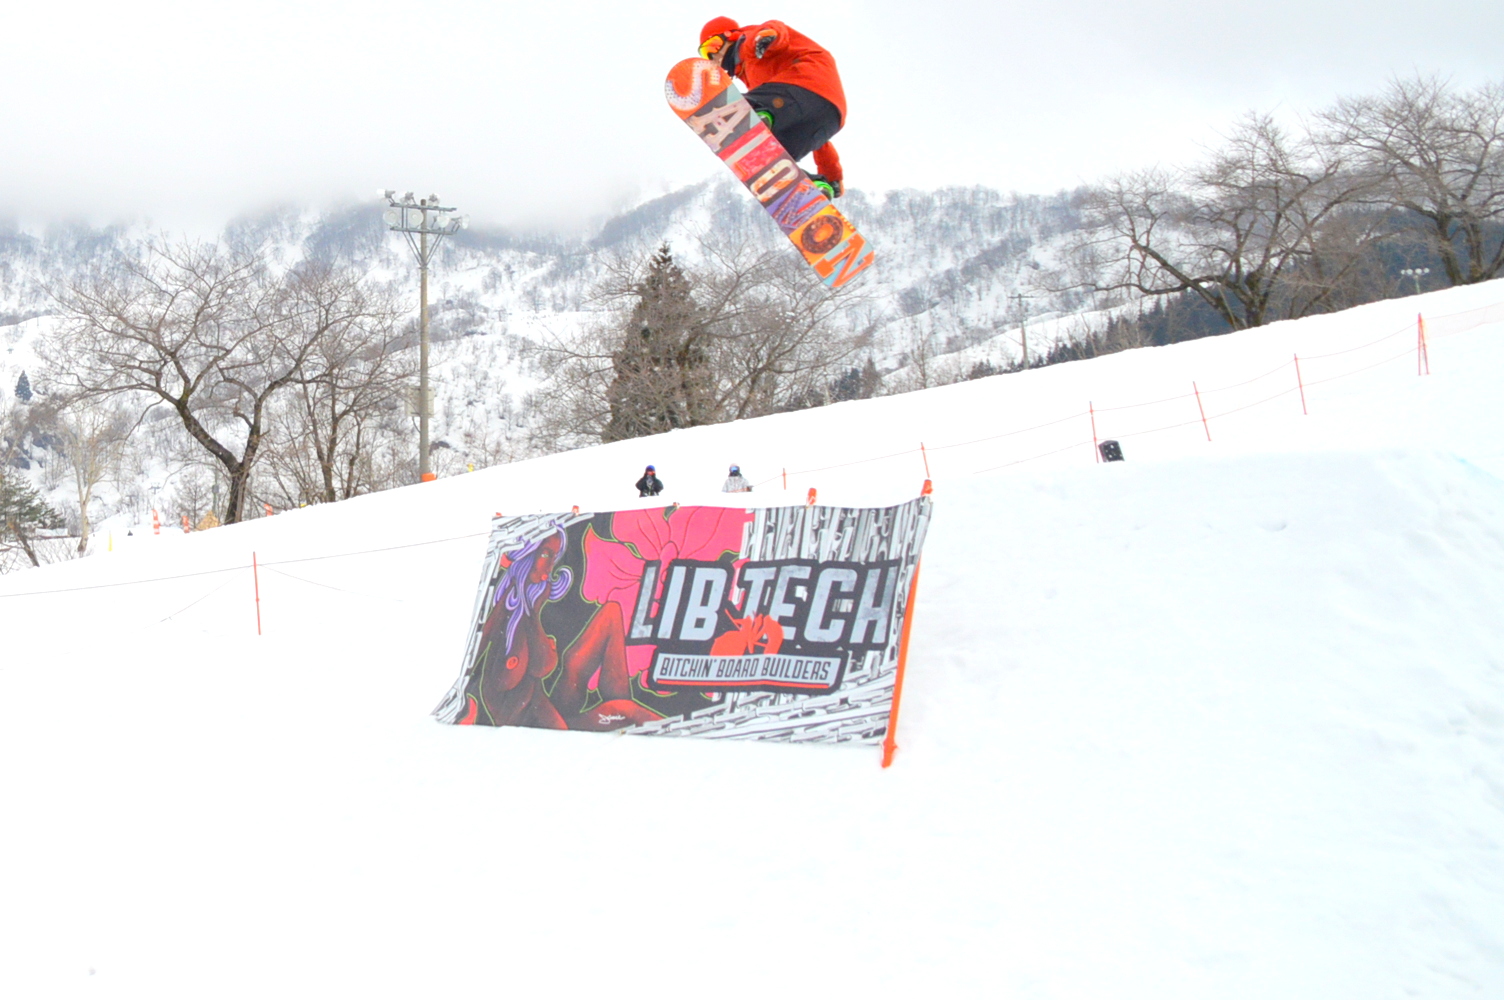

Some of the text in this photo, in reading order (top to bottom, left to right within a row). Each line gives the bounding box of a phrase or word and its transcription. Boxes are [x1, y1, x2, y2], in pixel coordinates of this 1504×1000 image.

[664, 58, 875, 288] SALOMON
[630, 564, 899, 644] LIB TECH
[659, 656, 832, 680] BITCHIN' BOARD BUILDERS
